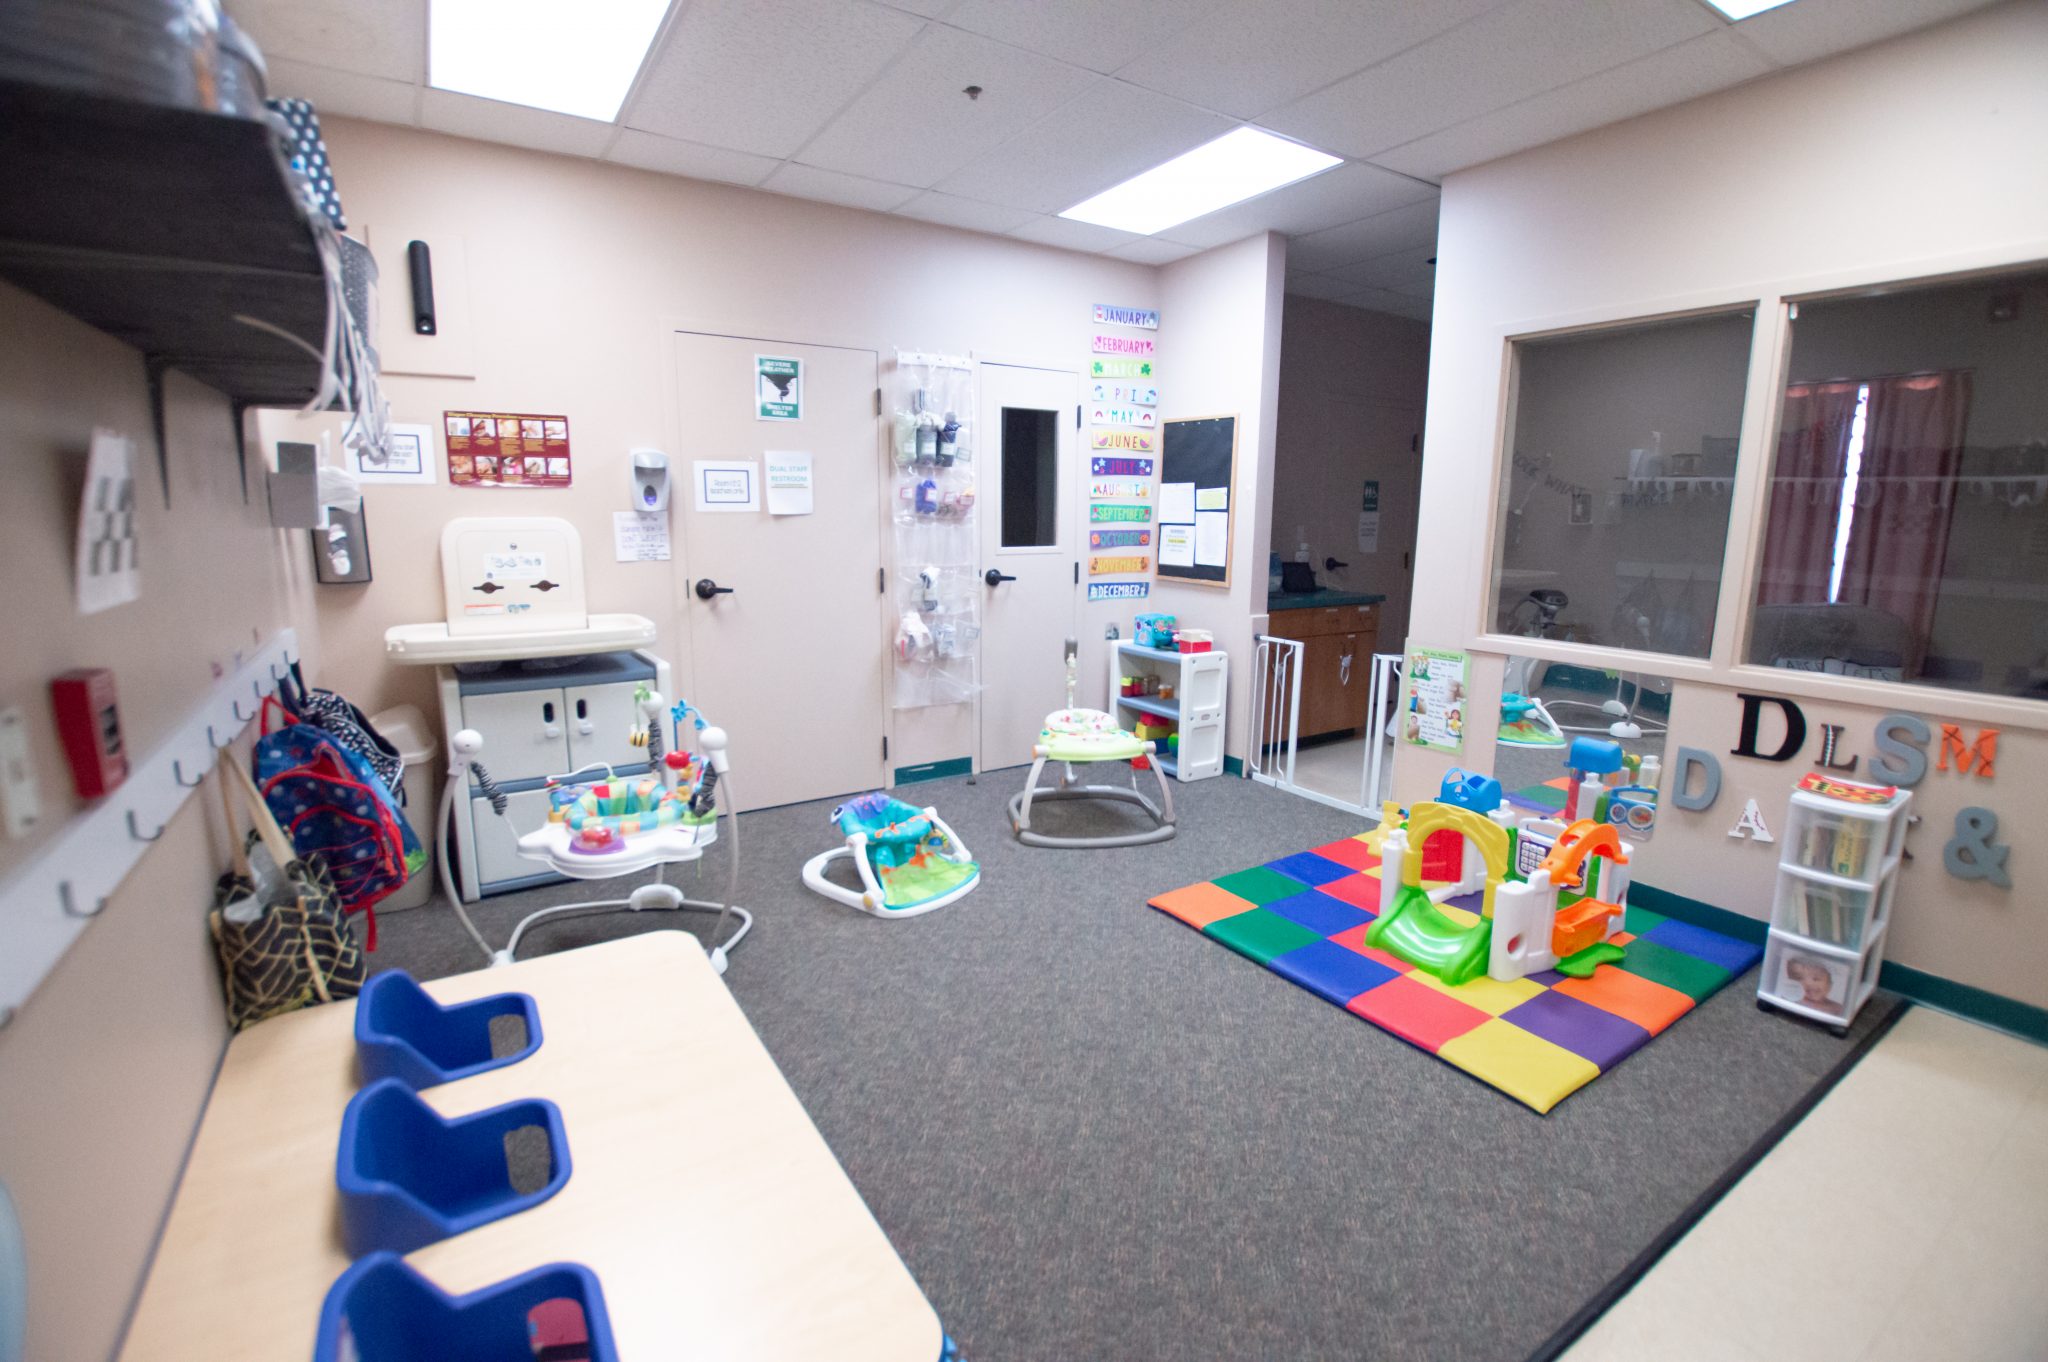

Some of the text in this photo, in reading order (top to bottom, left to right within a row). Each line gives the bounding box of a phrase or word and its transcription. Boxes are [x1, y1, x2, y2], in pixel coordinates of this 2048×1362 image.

[1104, 308, 1147, 326] JANUARY
[1102, 337, 1145, 354] FEBRUARY
[1104, 363, 1140, 377] MARCH
[1107, 387, 1143, 402] PRI
[1111, 410, 1134, 423] MAY
[1108, 435, 1138, 448] JUNE
[1109, 460, 1135, 473] JULY
[1102, 483, 1140, 497] AUGST
[1099, 506, 1144, 521] SEPTEMBER
[1100, 532, 1139, 546] OCTOBER
[1098, 558, 1141, 573] NOVEMBER
[1098, 585, 1140, 598] DECEMBER
[1731, 693, 2001, 788] D L S M
[1672, 746, 1722, 811] D
[1728, 799, 1774, 843] A
